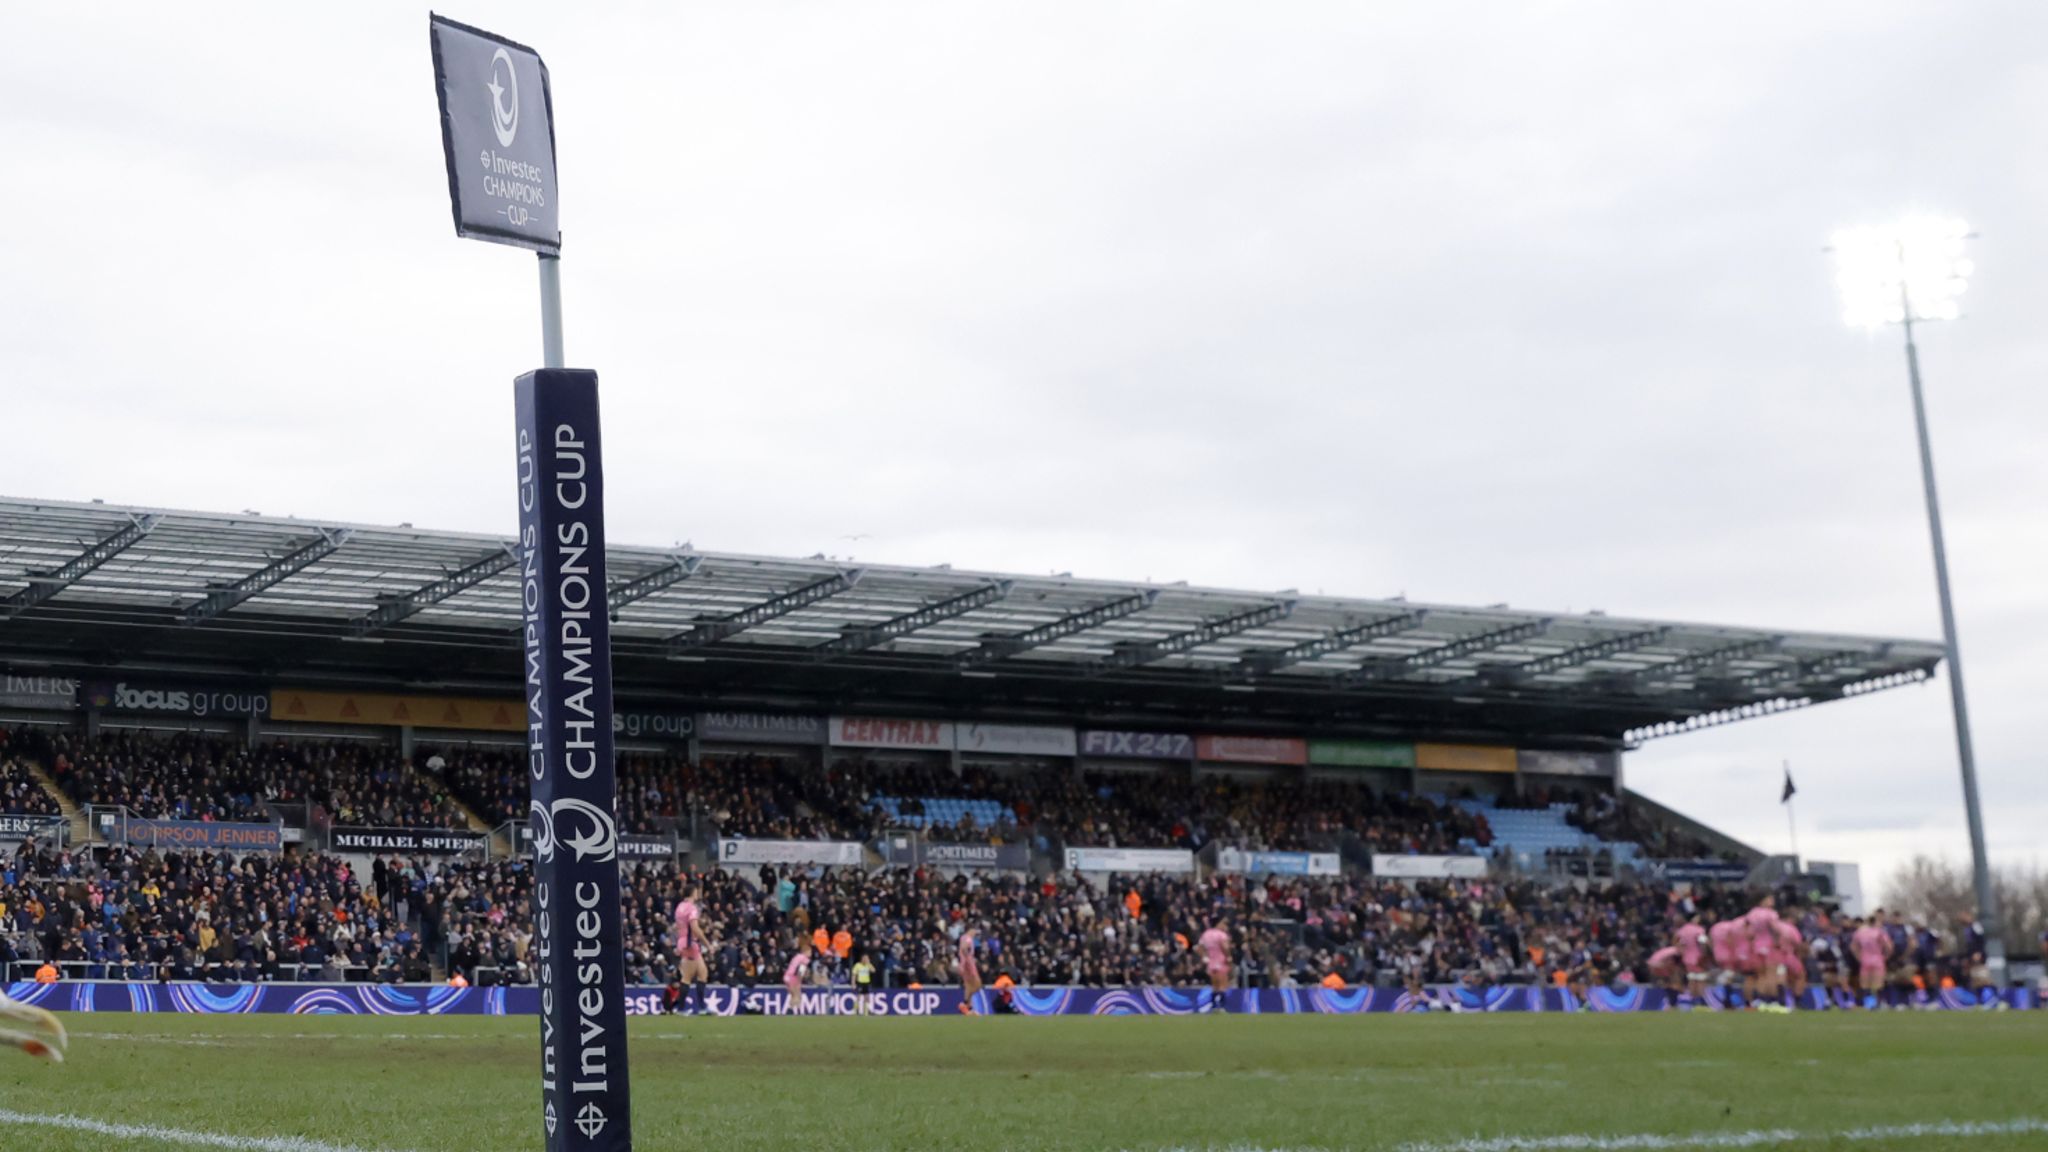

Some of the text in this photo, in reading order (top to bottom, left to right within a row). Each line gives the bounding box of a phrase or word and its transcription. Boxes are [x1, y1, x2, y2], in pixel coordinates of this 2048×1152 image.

[491, 150, 542, 183] Investec
[483, 175, 545, 207] CHAMPIONS
[507, 204, 528, 226] CUP
[841, 717, 942, 745] CENTRAX
[519, 428, 556, 1092] Investec CHAMPIONS CUP
[555, 423, 608, 1094] Investec CHAMPIONS CUP
[214, 827, 278, 845] JENNER
[336, 834, 485, 850] MICHAEL SPIERS
[892, 992, 940, 1015] CUP
